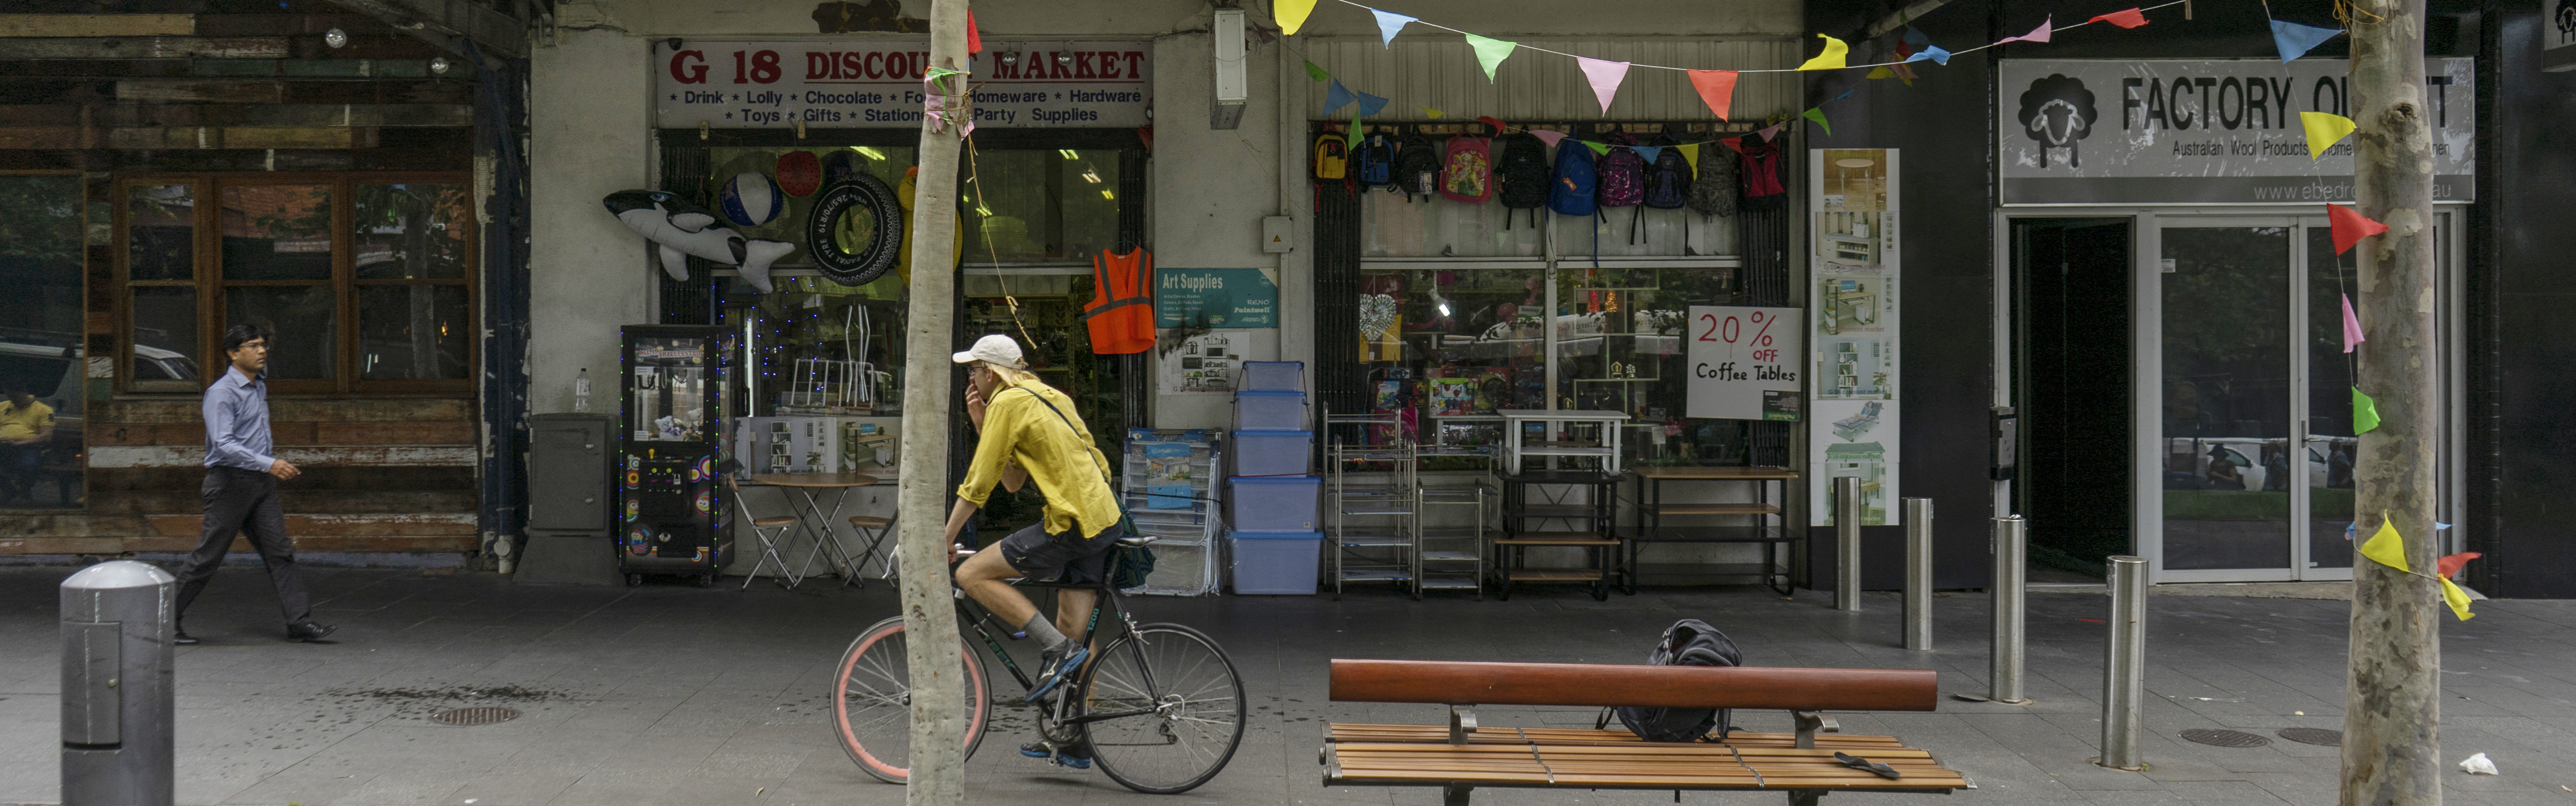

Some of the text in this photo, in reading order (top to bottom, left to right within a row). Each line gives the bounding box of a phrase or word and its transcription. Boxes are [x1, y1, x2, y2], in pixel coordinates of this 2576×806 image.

[670, 50, 1145, 84] G 18 DISCOU MARKET
[685, 91, 724, 104] Drink
[747, 91, 782, 108] Lolly
[805, 91, 882, 104] Chocolate
[1070, 89, 1142, 103] Hardware
[2122, 76, 2293, 130] FACTORY
[741, 109, 780, 125] Toys
[803, 109, 841, 122] Gifts
[974, 108, 1016, 124] Party
[1032, 107, 1098, 124] Supplies
[2173, 140, 2223, 156] Australian
[2231, 140, 2257, 156] Wool
[2263, 140, 2309, 156] Products
[820, 238, 835, 258] TYRE
[1163, 273, 1223, 292] Art Supplies
[1753, 349, 1779, 363] OFF
[1696, 362, 1796, 381] Coffee Tables
[1087, 608, 1100, 631] 1200
[983, 636, 1016, 671] TREK
